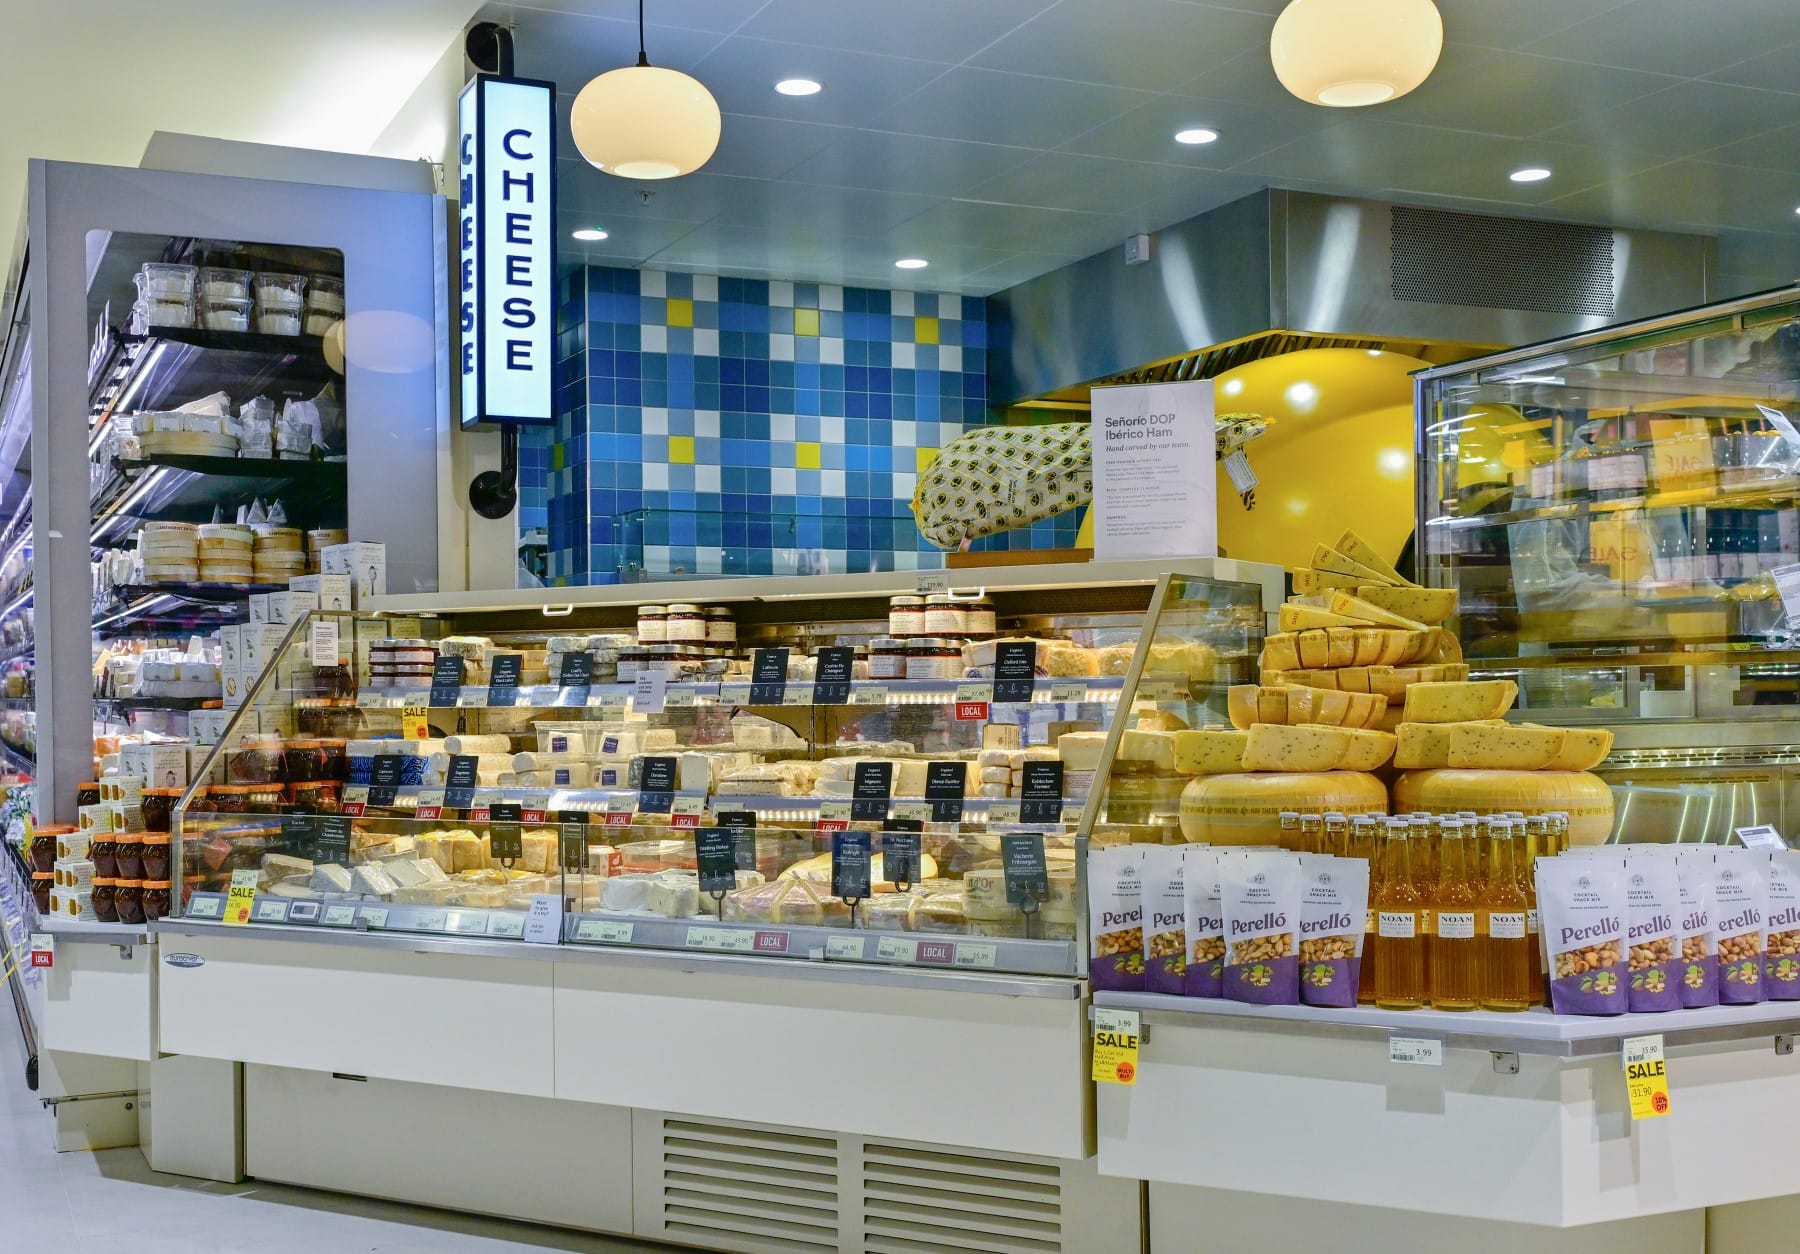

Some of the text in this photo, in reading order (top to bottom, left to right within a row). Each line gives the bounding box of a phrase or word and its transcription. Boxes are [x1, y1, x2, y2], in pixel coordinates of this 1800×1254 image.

[461, 133, 474, 376] CHEESE
[502, 128, 536, 371] CHEESE
[1105, 414, 1176, 428] Señorío DOP
[1105, 427, 1173, 440] Ibérico Ham
[1125, 443, 1147, 451] carved
[1149, 442, 1157, 451] by
[404, 707, 426, 717] SALE
[961, 706, 982, 716] LOCAL
[420, 809, 436, 817] LOCAL
[524, 813, 540, 822] LOCAL
[610, 816, 626, 824] LOCAL
[676, 818, 694, 826] LOCAL
[231, 887, 254, 898] SALE
[1103, 905, 1143, 927] Perel
[1718, 908, 1760, 932] erelló
[1232, 912, 1286, 935] Perelló
[1300, 913, 1351, 933] erelló
[1628, 915, 1671, 939] erelló
[1560, 916, 1620, 945] Perelló
[760, 936, 781, 947] LOCAL
[923, 947, 946, 959] LOCAL
[1096, 1032, 1137, 1049] SALE
[1416, 1048, 1432, 1056] 3.99
[1628, 1061, 1665, 1079] SALE
